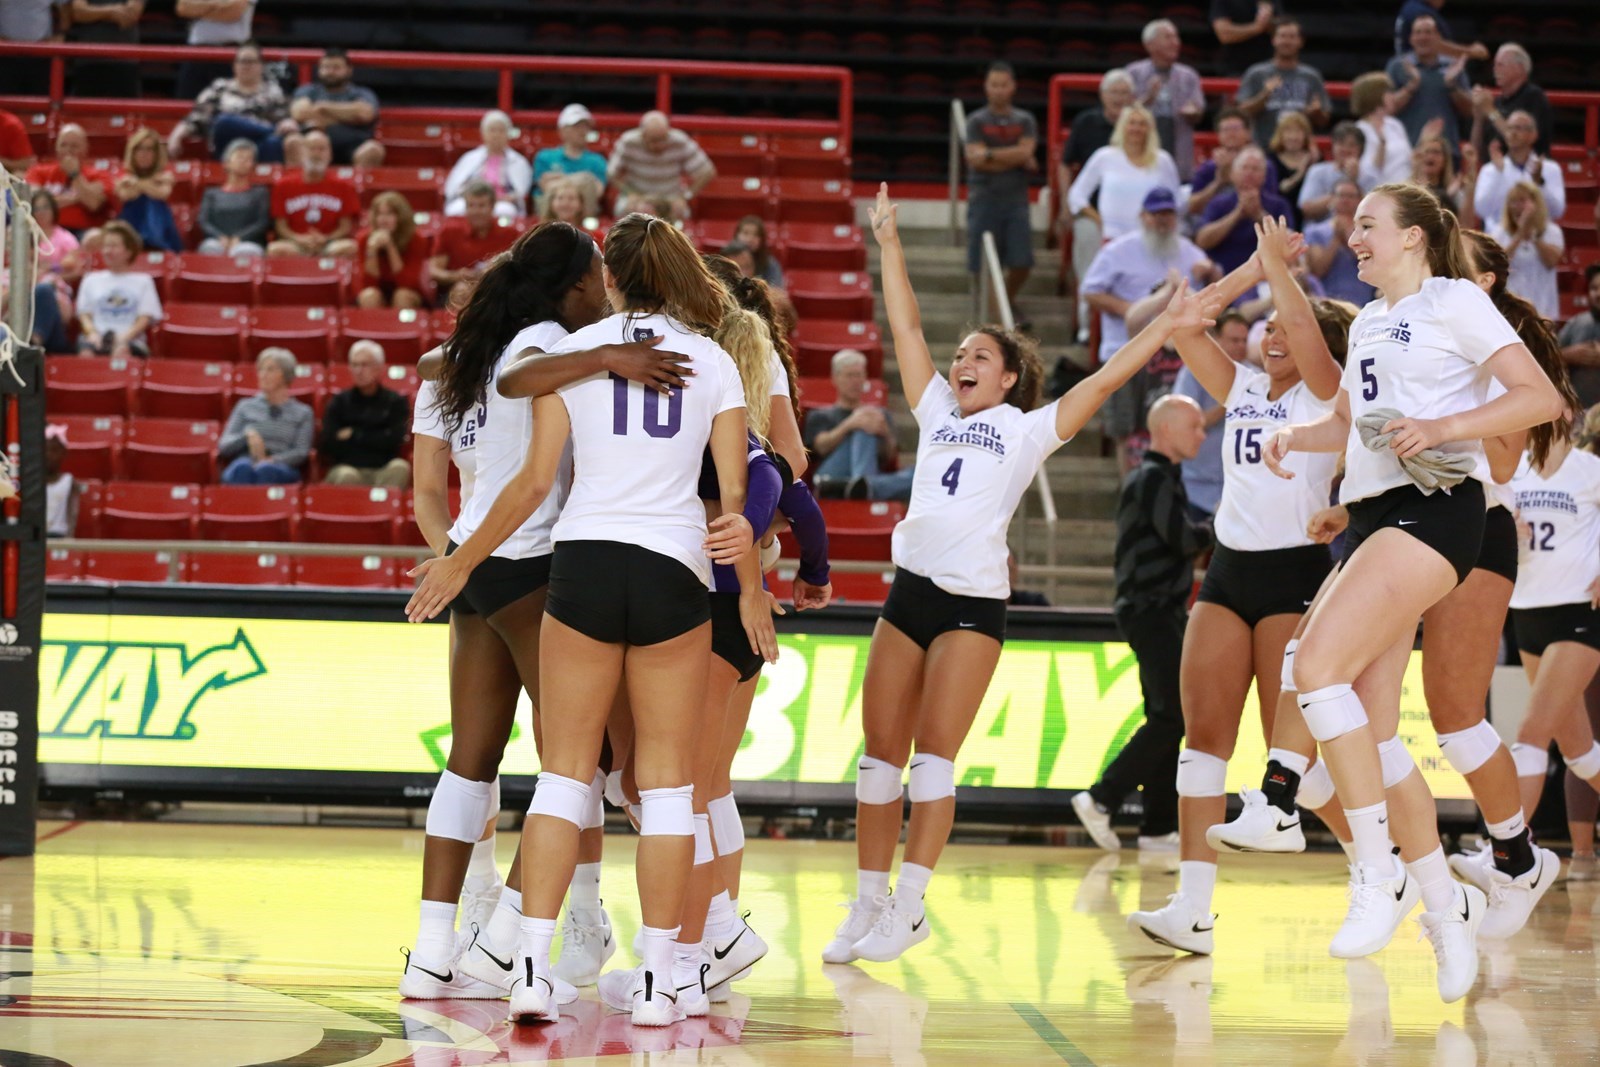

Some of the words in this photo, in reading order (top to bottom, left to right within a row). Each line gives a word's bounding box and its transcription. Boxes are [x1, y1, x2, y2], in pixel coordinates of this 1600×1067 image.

[1360, 357, 1378, 402] 5
[1235, 428, 1262, 465] 15
[941, 457, 963, 496] 4
[1528, 521, 1555, 551] 12
